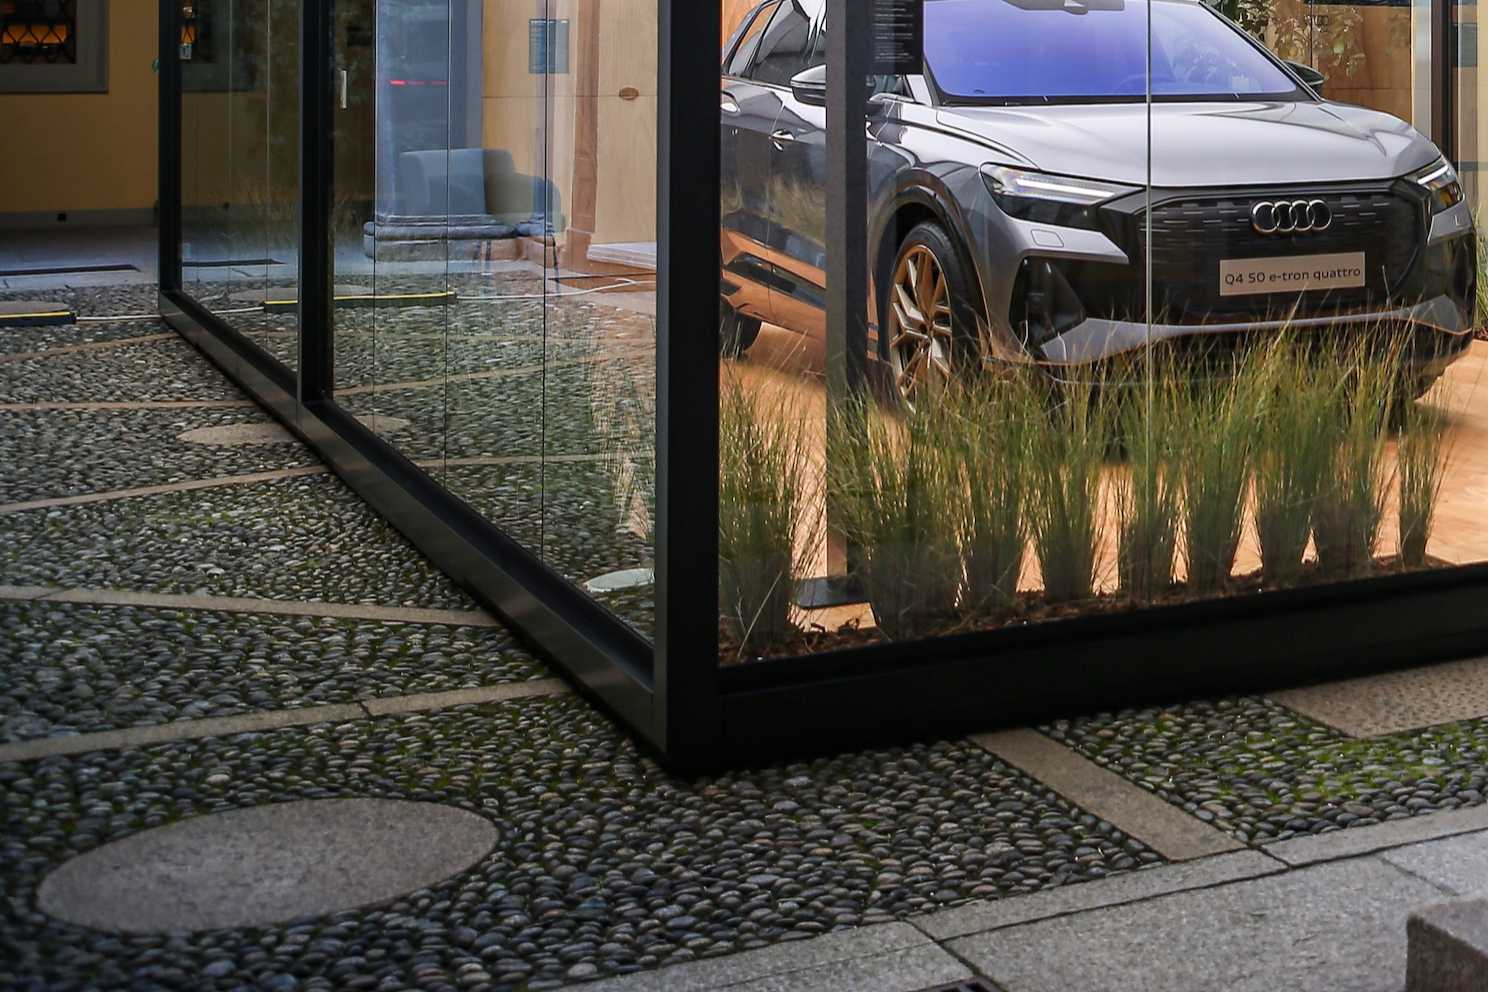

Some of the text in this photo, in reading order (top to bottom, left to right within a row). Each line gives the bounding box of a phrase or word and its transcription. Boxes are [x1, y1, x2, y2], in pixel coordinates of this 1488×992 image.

[1224, 267, 1361, 286] Q4 50 e-tron quattro
